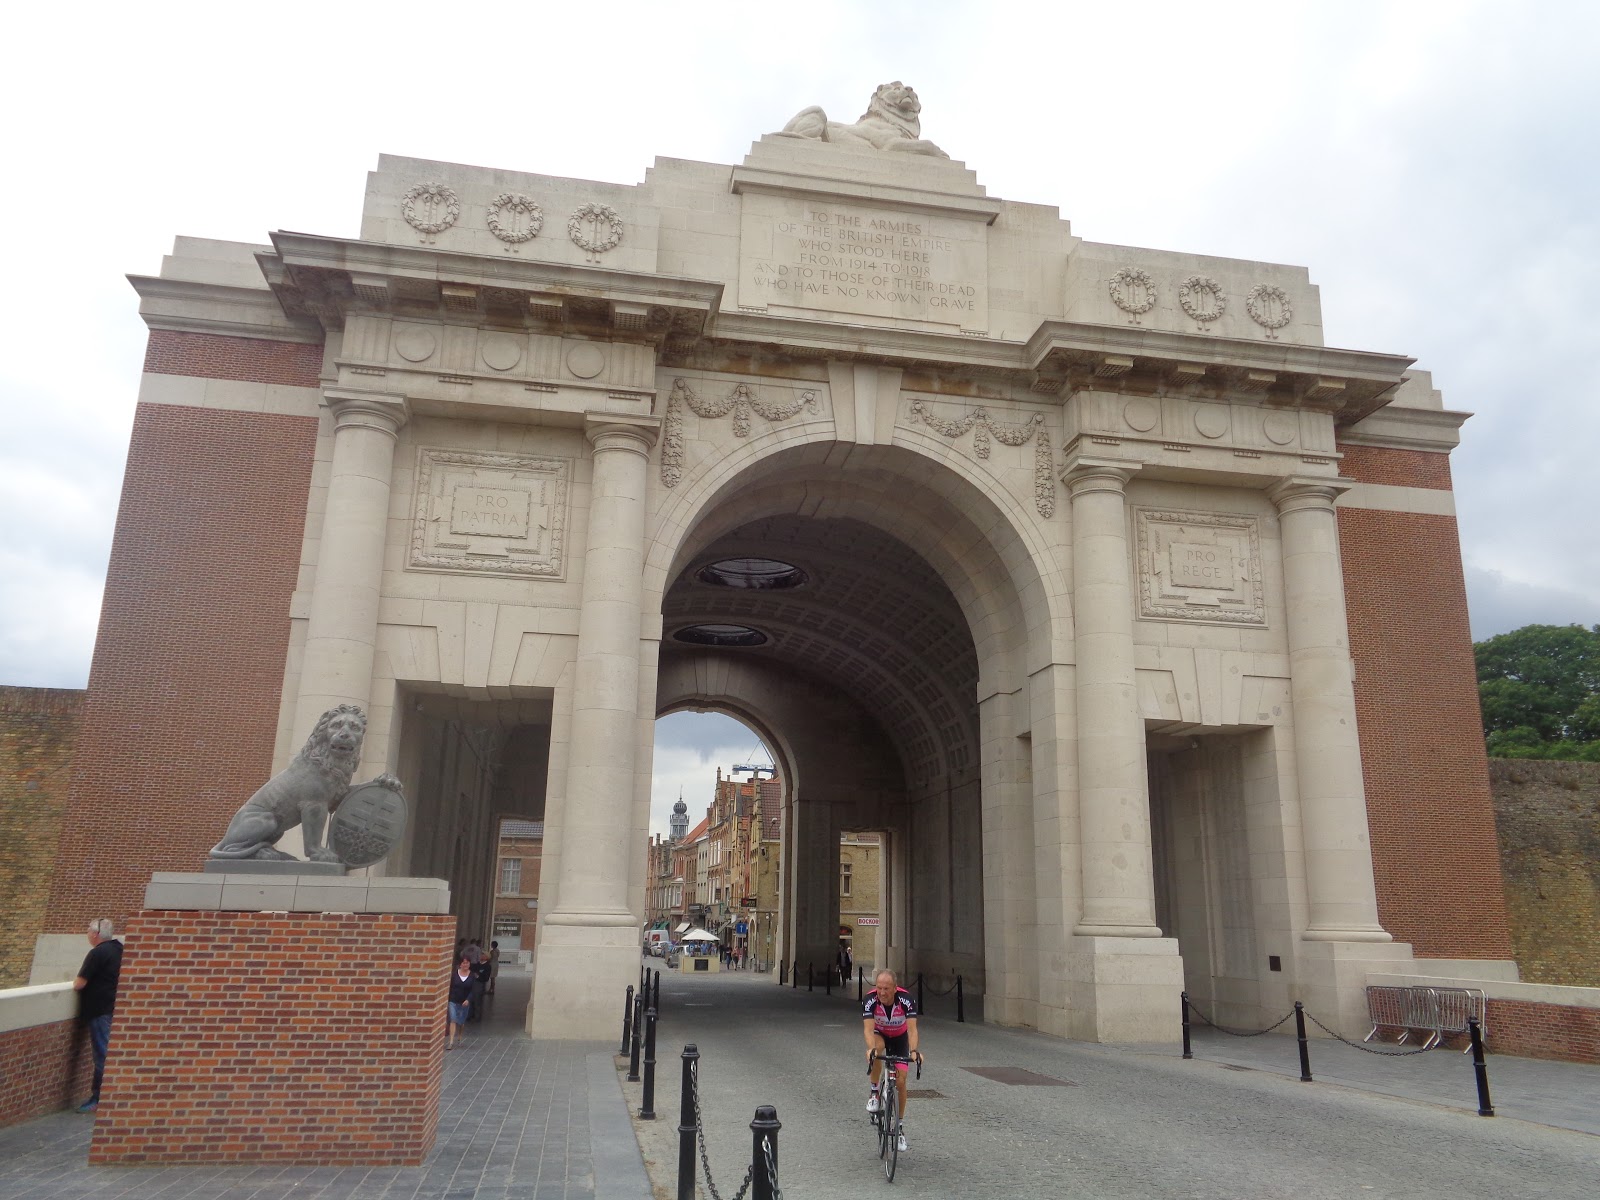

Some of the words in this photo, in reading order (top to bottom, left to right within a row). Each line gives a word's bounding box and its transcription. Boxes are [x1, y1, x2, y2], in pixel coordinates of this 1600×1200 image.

[811, 211, 828, 223] TO
[835, 213, 861, 228] THE
[869, 218, 922, 235] ARMIES
[778, 222, 796, 233] OF
[803, 224, 830, 238] THE
[839, 229, 894, 246] BRITISH
[902, 236, 952, 252] EMPIRE
[798, 238, 831, 252] WHO
[838, 243, 884, 259] STOOD
[891, 250, 930, 264] HERE
[800, 253, 843, 267] FROM
[849, 259, 877, 271] 1914
[883, 262, 901, 274] TO
[906, 264, 931, 278] 1918
[755, 263, 789, 276] AND
[795, 266, 813, 278] TO
[820, 269, 864, 285] THOSE
[871, 275, 890, 287] OF
[894, 277, 935, 292] THEIR
[939, 283, 976, 297] DEAD
[753, 276, 788, 290] WHO
[794, 281, 829, 295] HAVE
[837, 285, 859, 298] NO
[866, 289, 921, 305] KNOWN
[929, 296, 976, 312] GRAVE
[476, 494, 509, 509] PRO
[461, 510, 519, 526] PATRIA
[1187, 550, 1216, 563] PRO
[1182, 565, 1222, 579] REGE
